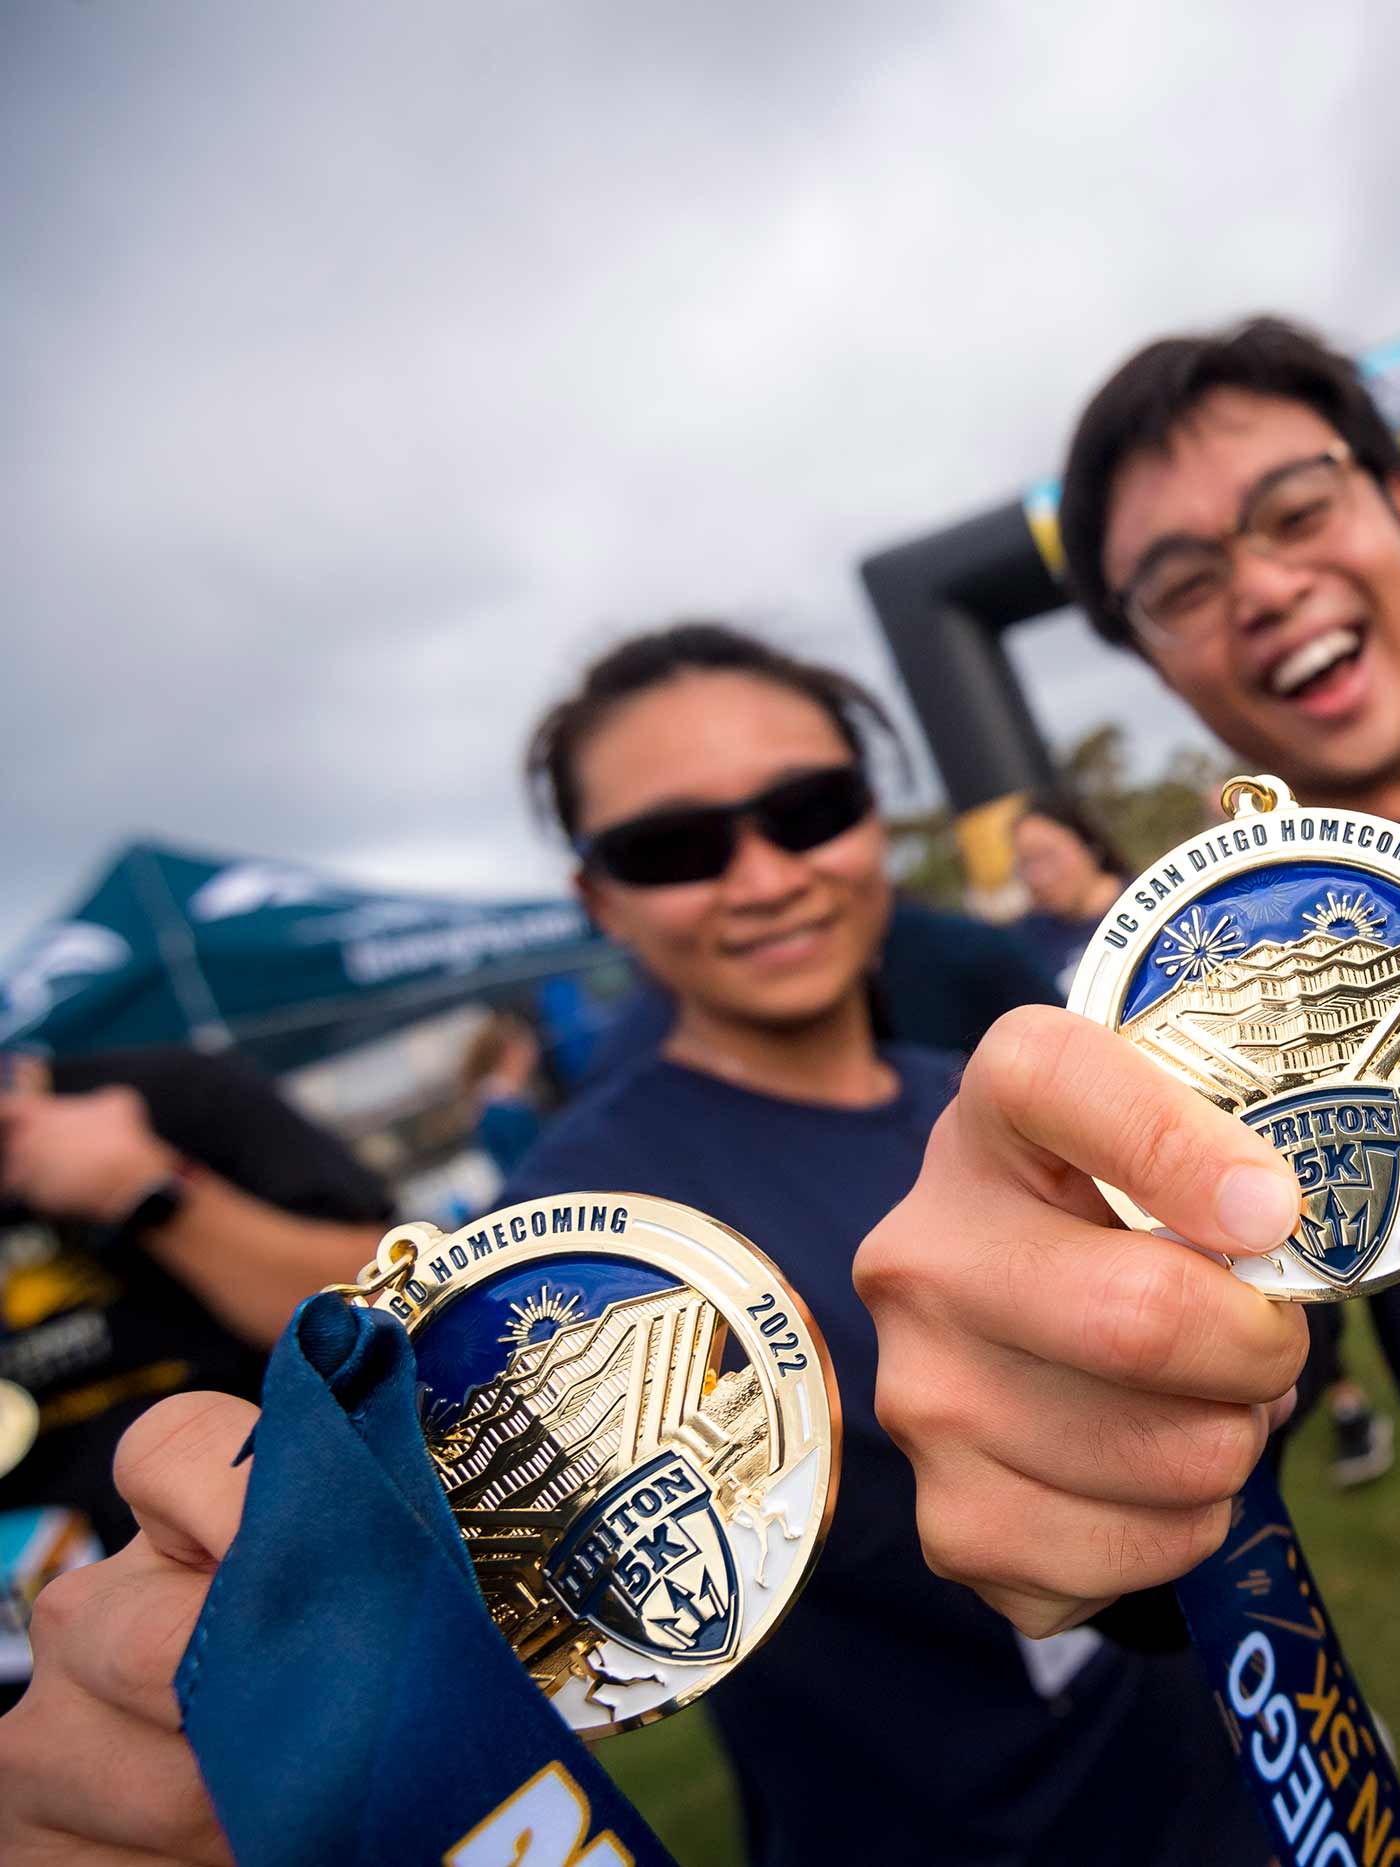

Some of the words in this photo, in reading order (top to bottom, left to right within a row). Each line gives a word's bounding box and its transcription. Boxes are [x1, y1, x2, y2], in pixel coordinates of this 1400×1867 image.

[1104, 913, 1139, 950] UC
[1134, 863, 1185, 913] SAN
[1187, 823, 1269, 874] DIEGO
[1256, 1104, 1396, 1147] RITON
[1293, 1143, 1363, 1188] 5K
[428, 1205, 629, 1285] HOMECOMING
[745, 1292, 809, 1379] 2022
[558, 1467, 697, 1599] TRITON
[613, 1522, 689, 1600] 5K
[1295, 1650, 1359, 1791] 5K
